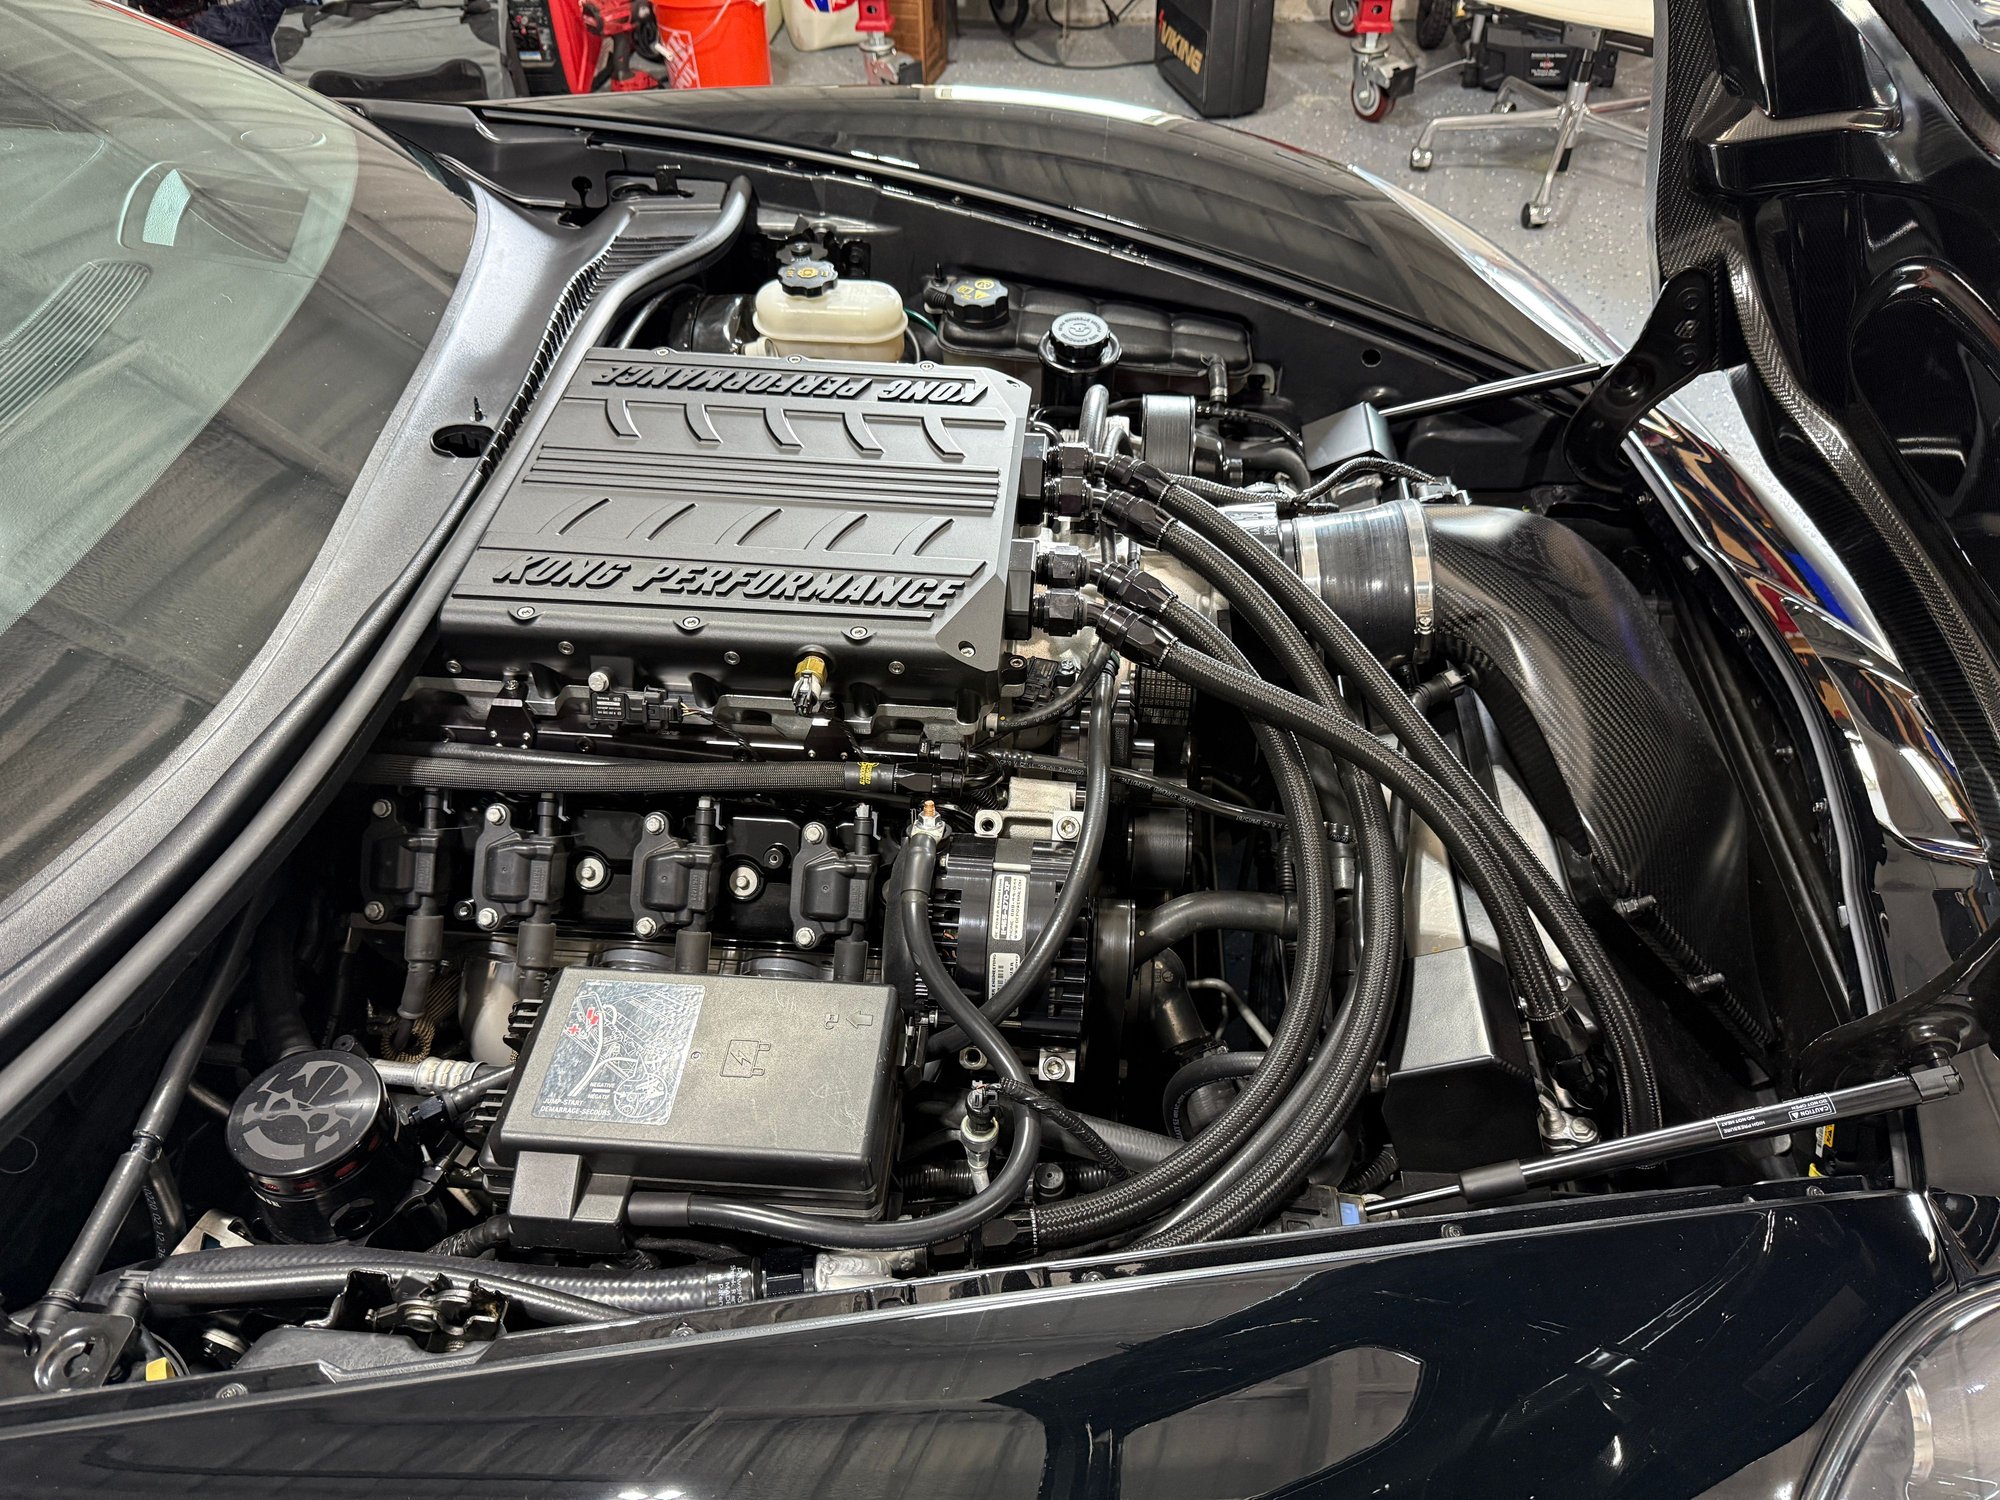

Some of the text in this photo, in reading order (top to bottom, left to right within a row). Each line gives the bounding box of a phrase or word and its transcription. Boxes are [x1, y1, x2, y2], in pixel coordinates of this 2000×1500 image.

[1160, 20, 1204, 75] VIKING
[591, 365, 989, 407] KONG PERFORMANCE
[492, 556, 966, 609] KONG PERFORMANCE
[590, 1081, 616, 1089] NEGATIVE
[543, 1098, 584, 1107] JUMP-START
[1791, 1103, 1807, 1111] OPEN
[1800, 1105, 1829, 1117] CAUTION
[1723, 1120, 1766, 1134] HIGH PRESSURE
